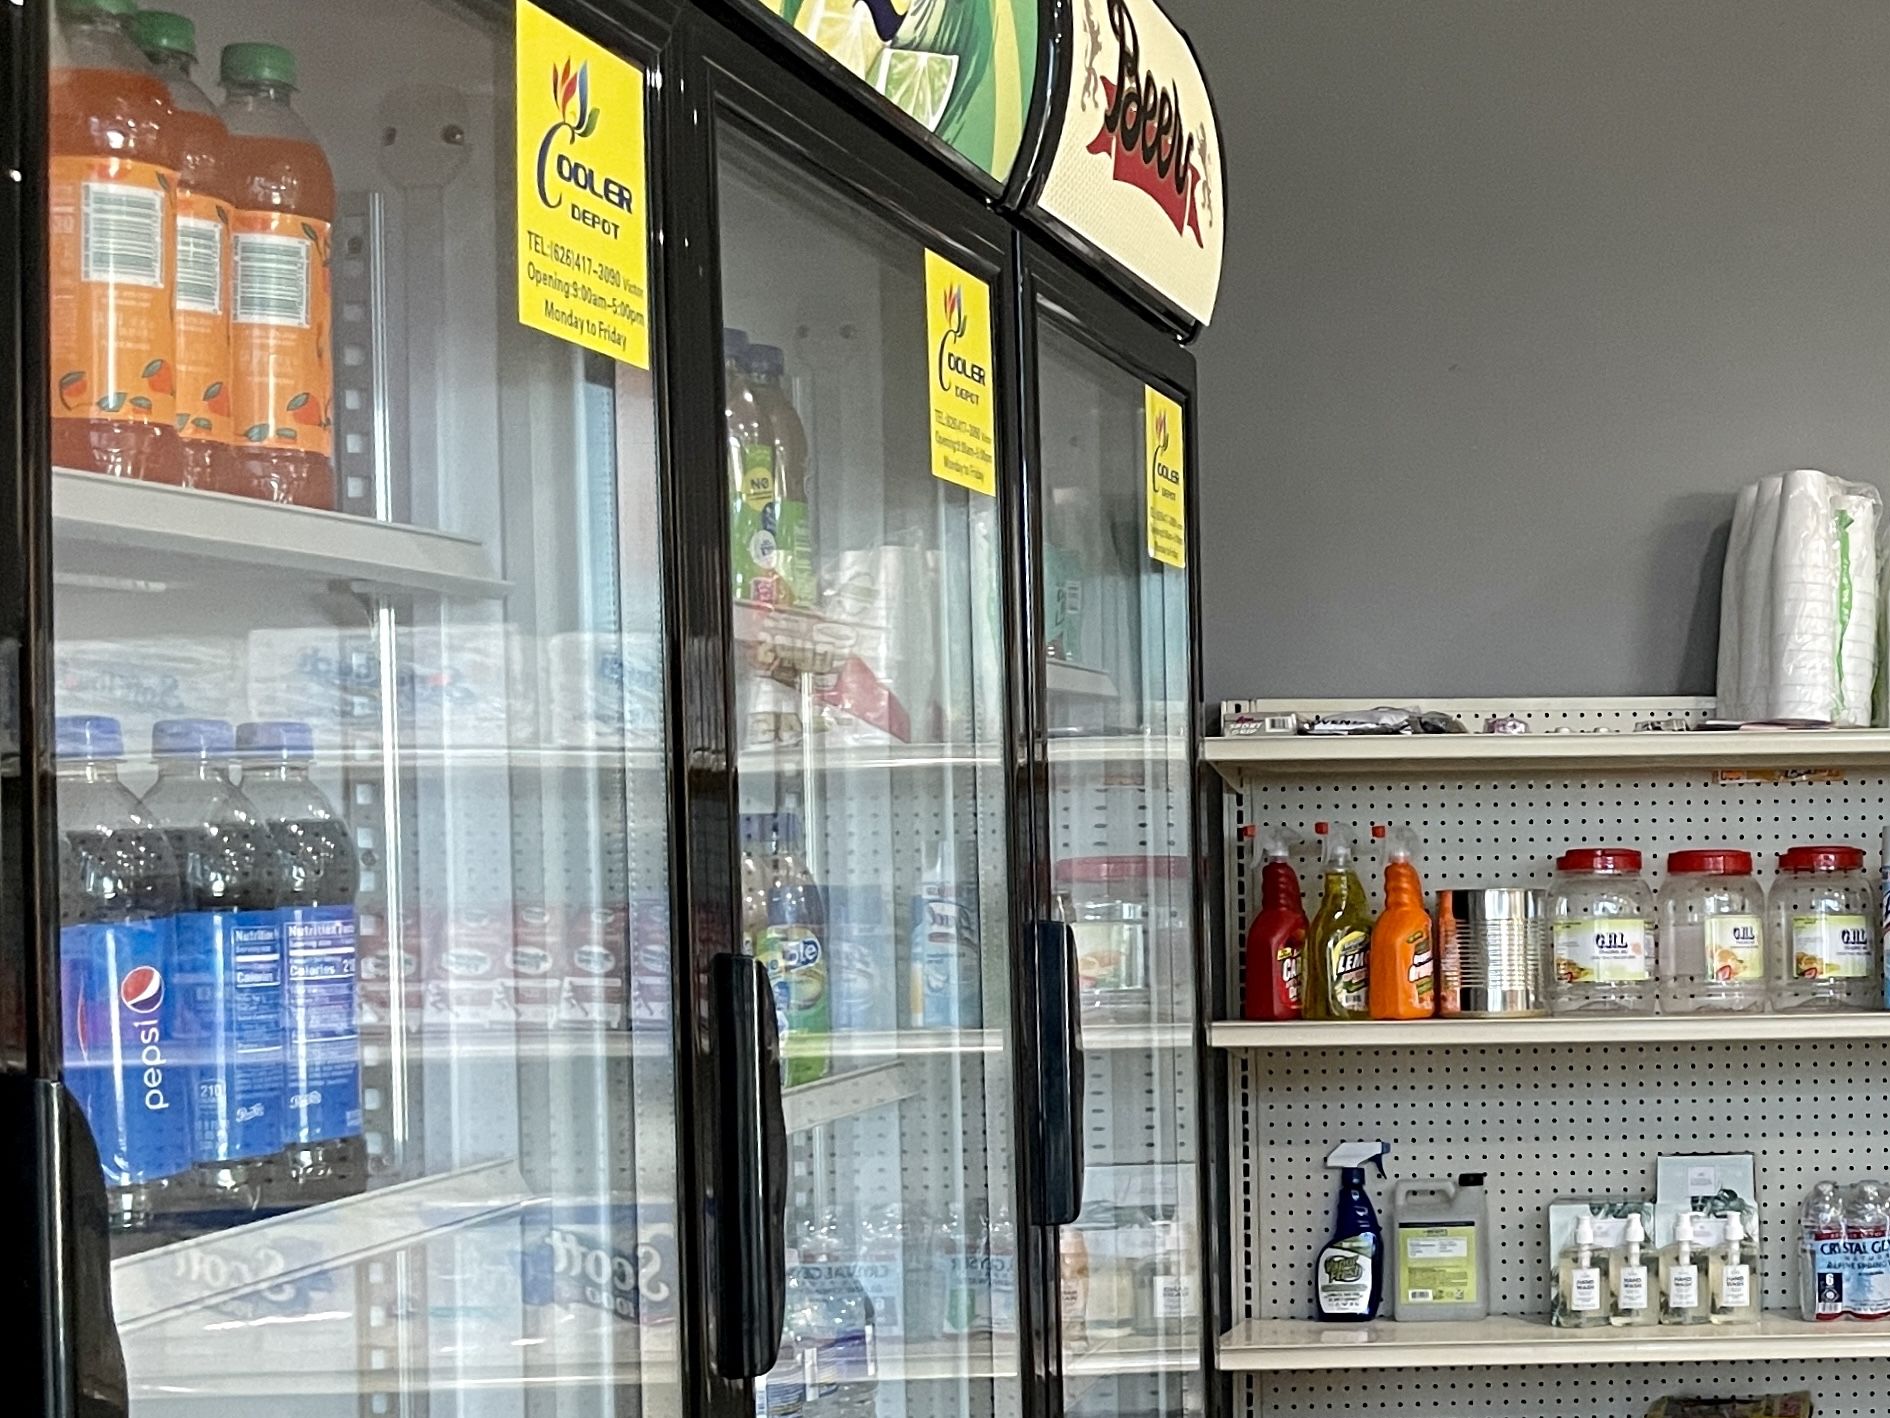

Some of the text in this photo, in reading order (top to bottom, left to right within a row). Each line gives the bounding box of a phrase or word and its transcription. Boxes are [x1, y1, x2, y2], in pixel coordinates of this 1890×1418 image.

[537, 121, 632, 214] COOLER
[571, 203, 620, 240] DEPOT
[545, 299, 627, 348] Monday to Friday
[133, 1018, 170, 1111] pepsi
[1825, 1273, 1835, 1286] 6
